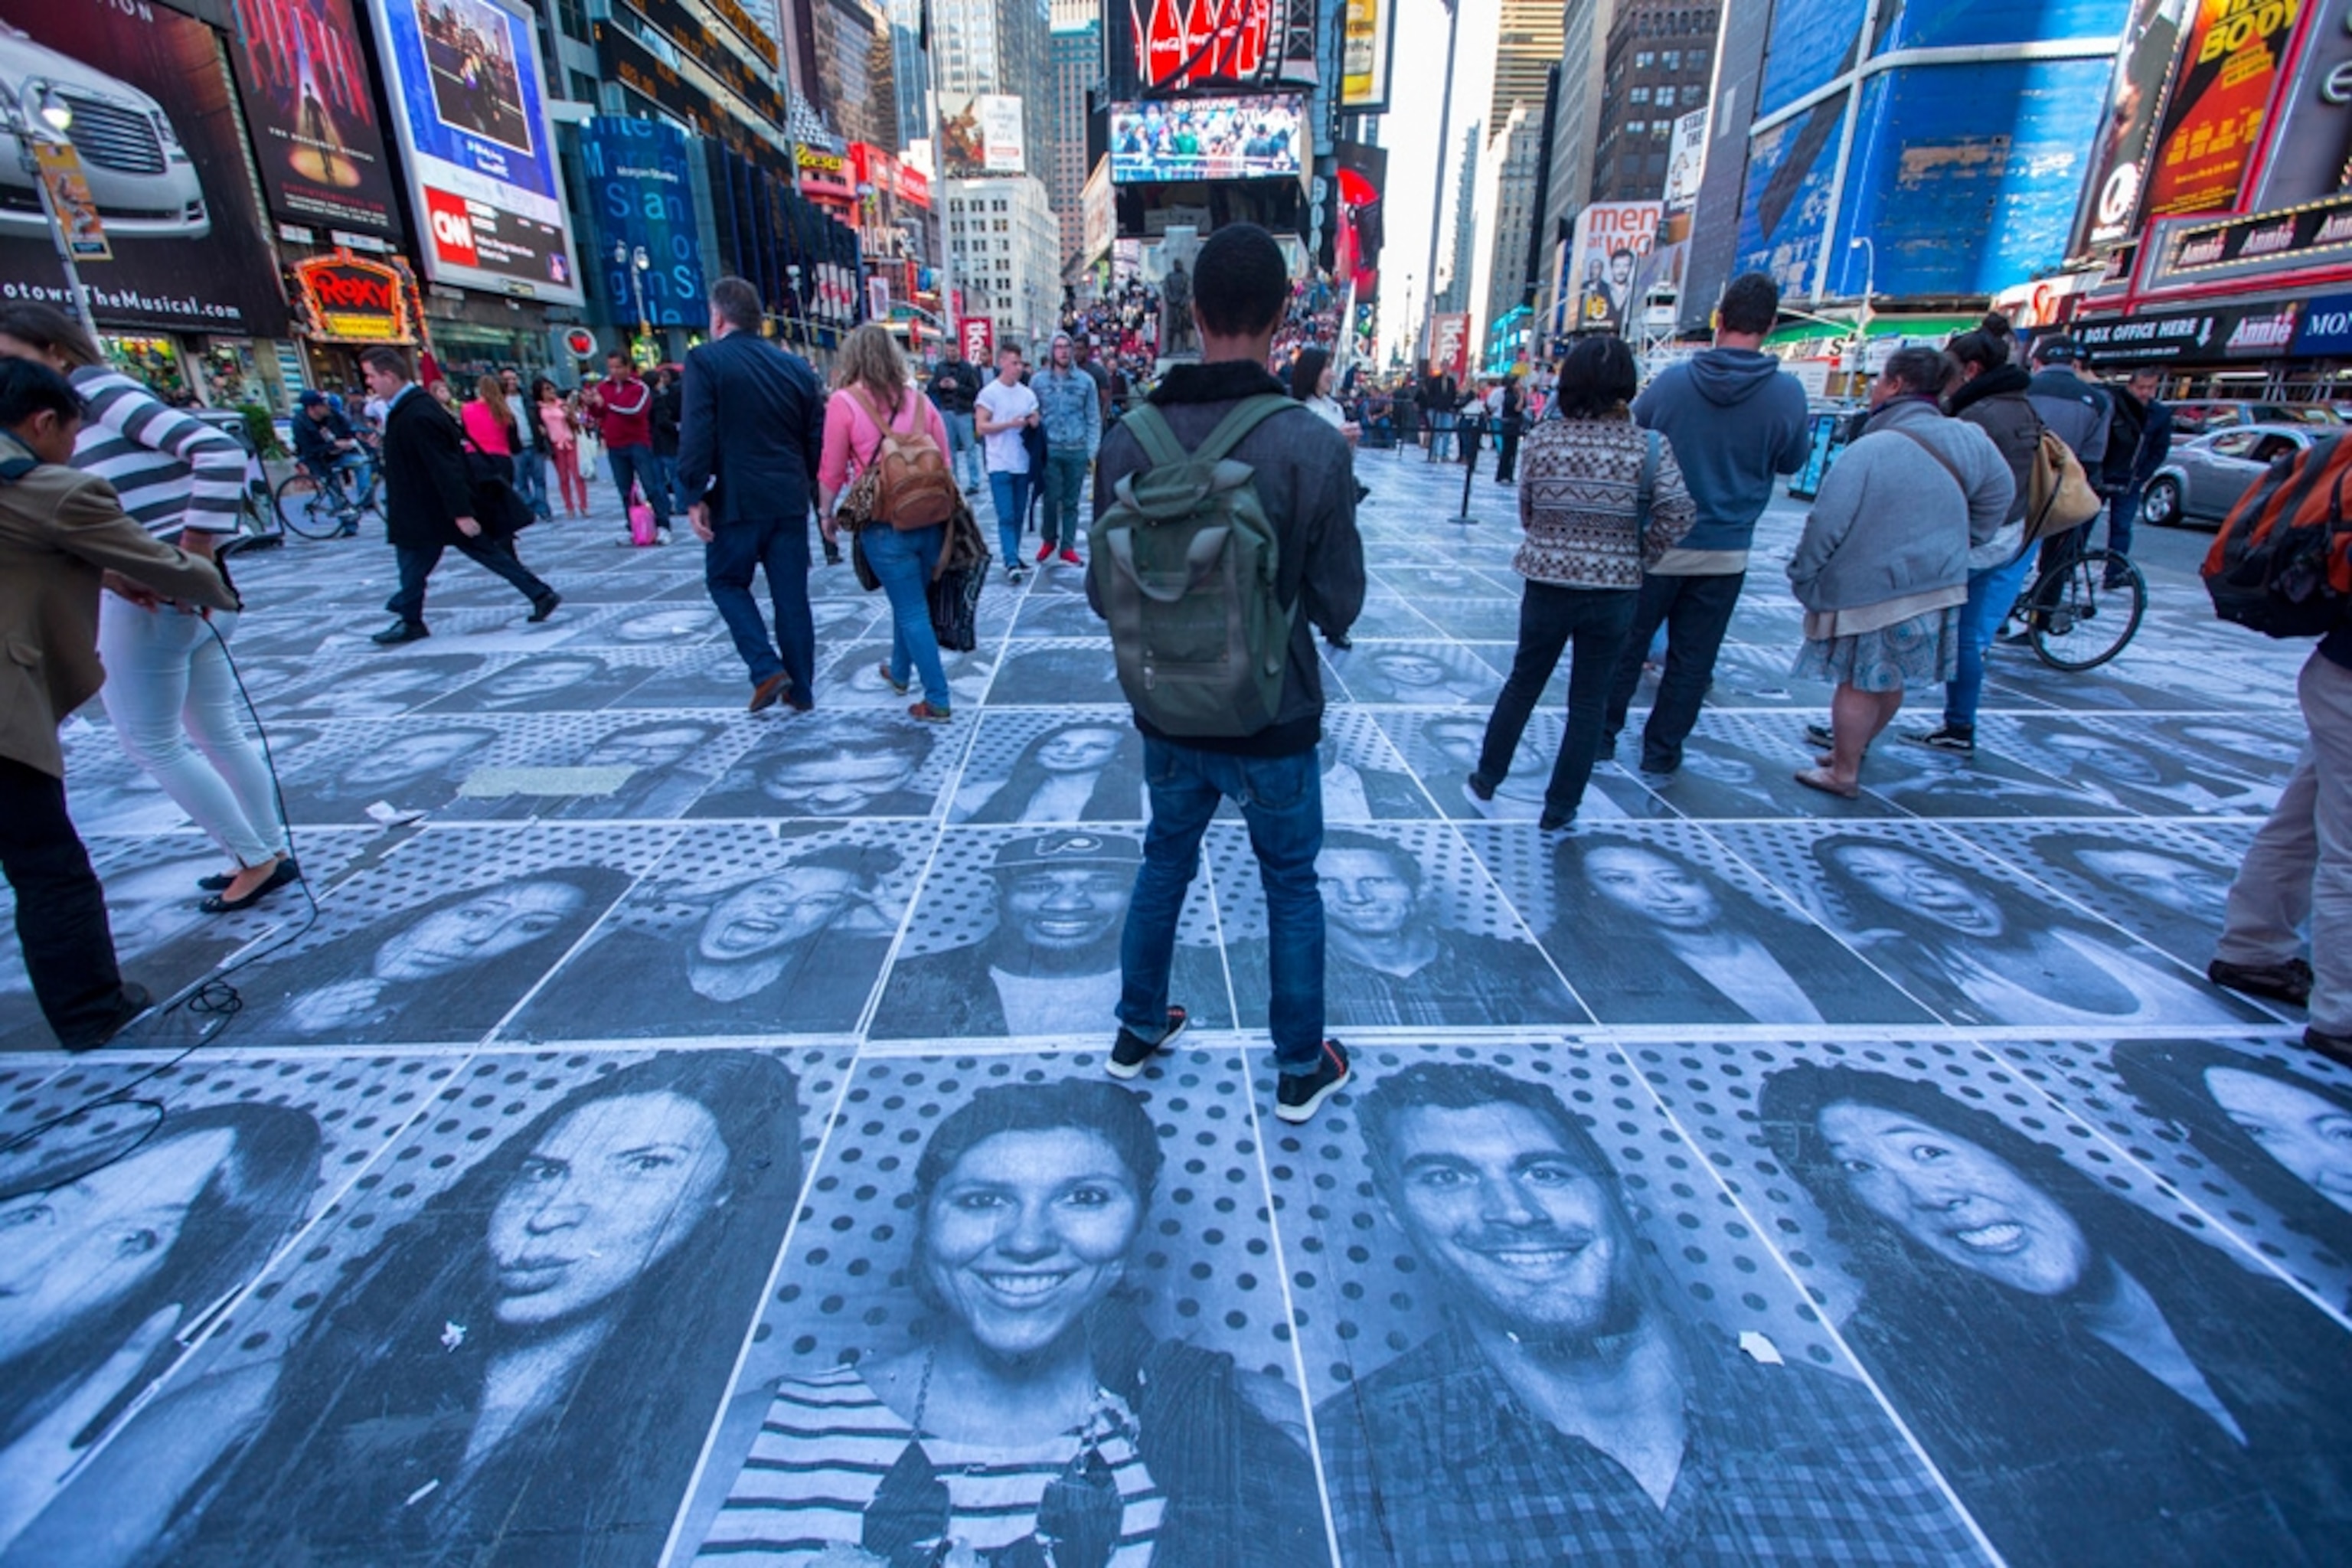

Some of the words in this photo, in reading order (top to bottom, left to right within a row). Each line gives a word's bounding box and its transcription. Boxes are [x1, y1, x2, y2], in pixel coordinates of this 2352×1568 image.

[432, 209, 472, 250] CNN
[1589, 205, 1659, 233] men
[1587, 235, 1602, 248] at
[2178, 235, 2226, 266] Annie
[2239, 223, 2295, 256] Annie
[307, 268, 390, 309] ROXY
[2084, 325, 2112, 344] BOX
[2112, 321, 2158, 341] OFFICE
[2158, 317, 2199, 338] HERE
[2225, 312, 2293, 348] Annie
